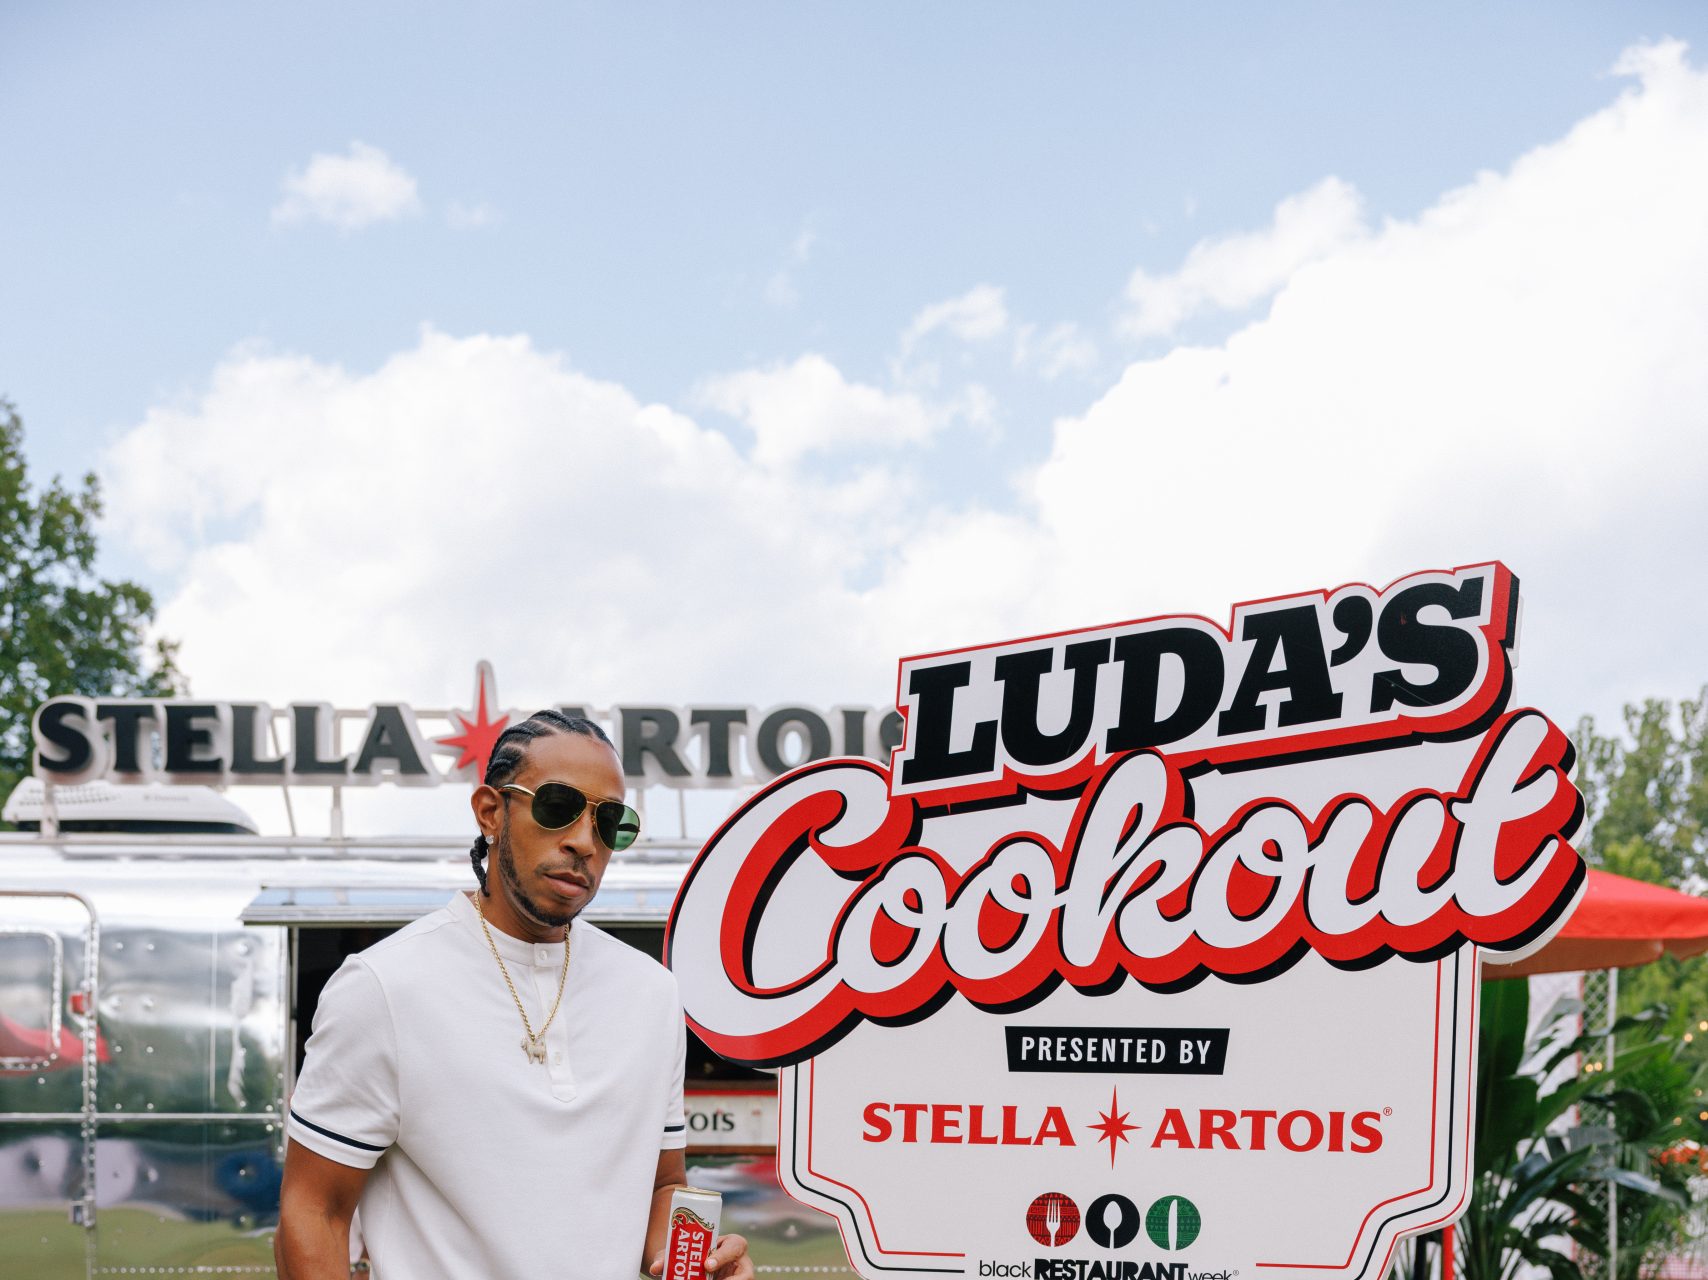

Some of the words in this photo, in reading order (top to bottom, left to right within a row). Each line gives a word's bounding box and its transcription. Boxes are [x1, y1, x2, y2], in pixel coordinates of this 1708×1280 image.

[901, 575, 1485, 786] LUDA'S
[37, 700, 430, 775] STELLA
[561, 706, 905, 778] RTOI
[669, 713, 1560, 1038] Cookout
[1020, 1035, 1167, 1064] PRESENTED
[1178, 1038, 1212, 1065] BY
[862, 1101, 1077, 1147] STELLA
[979, 1259, 1032, 1279] black
